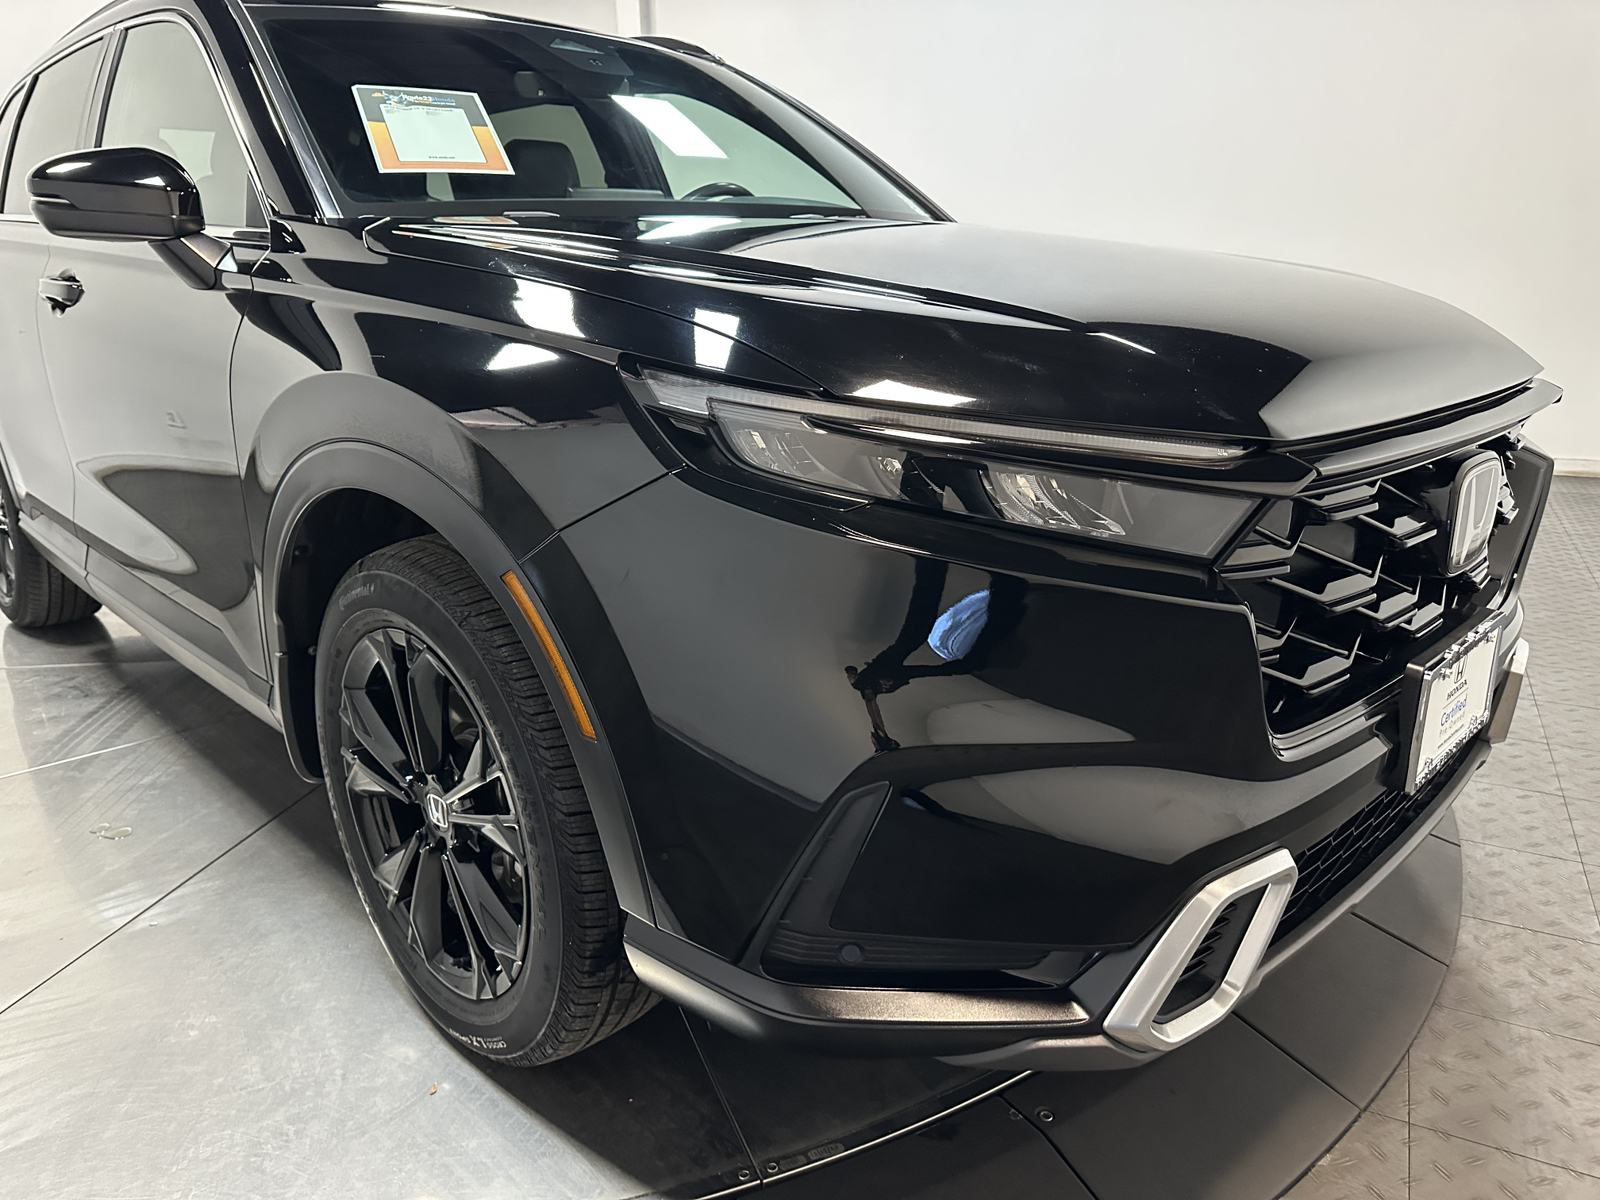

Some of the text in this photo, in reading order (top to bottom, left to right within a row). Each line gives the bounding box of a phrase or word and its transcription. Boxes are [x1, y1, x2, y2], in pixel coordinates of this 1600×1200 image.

[1446, 679, 1468, 701] HONDA
[1441, 693, 1468, 727] Certified
[1439, 710, 1466, 738] Pre-Owned
[449, 1028, 471, 1043] SPORT
[469, 1035, 487, 1048] LX
